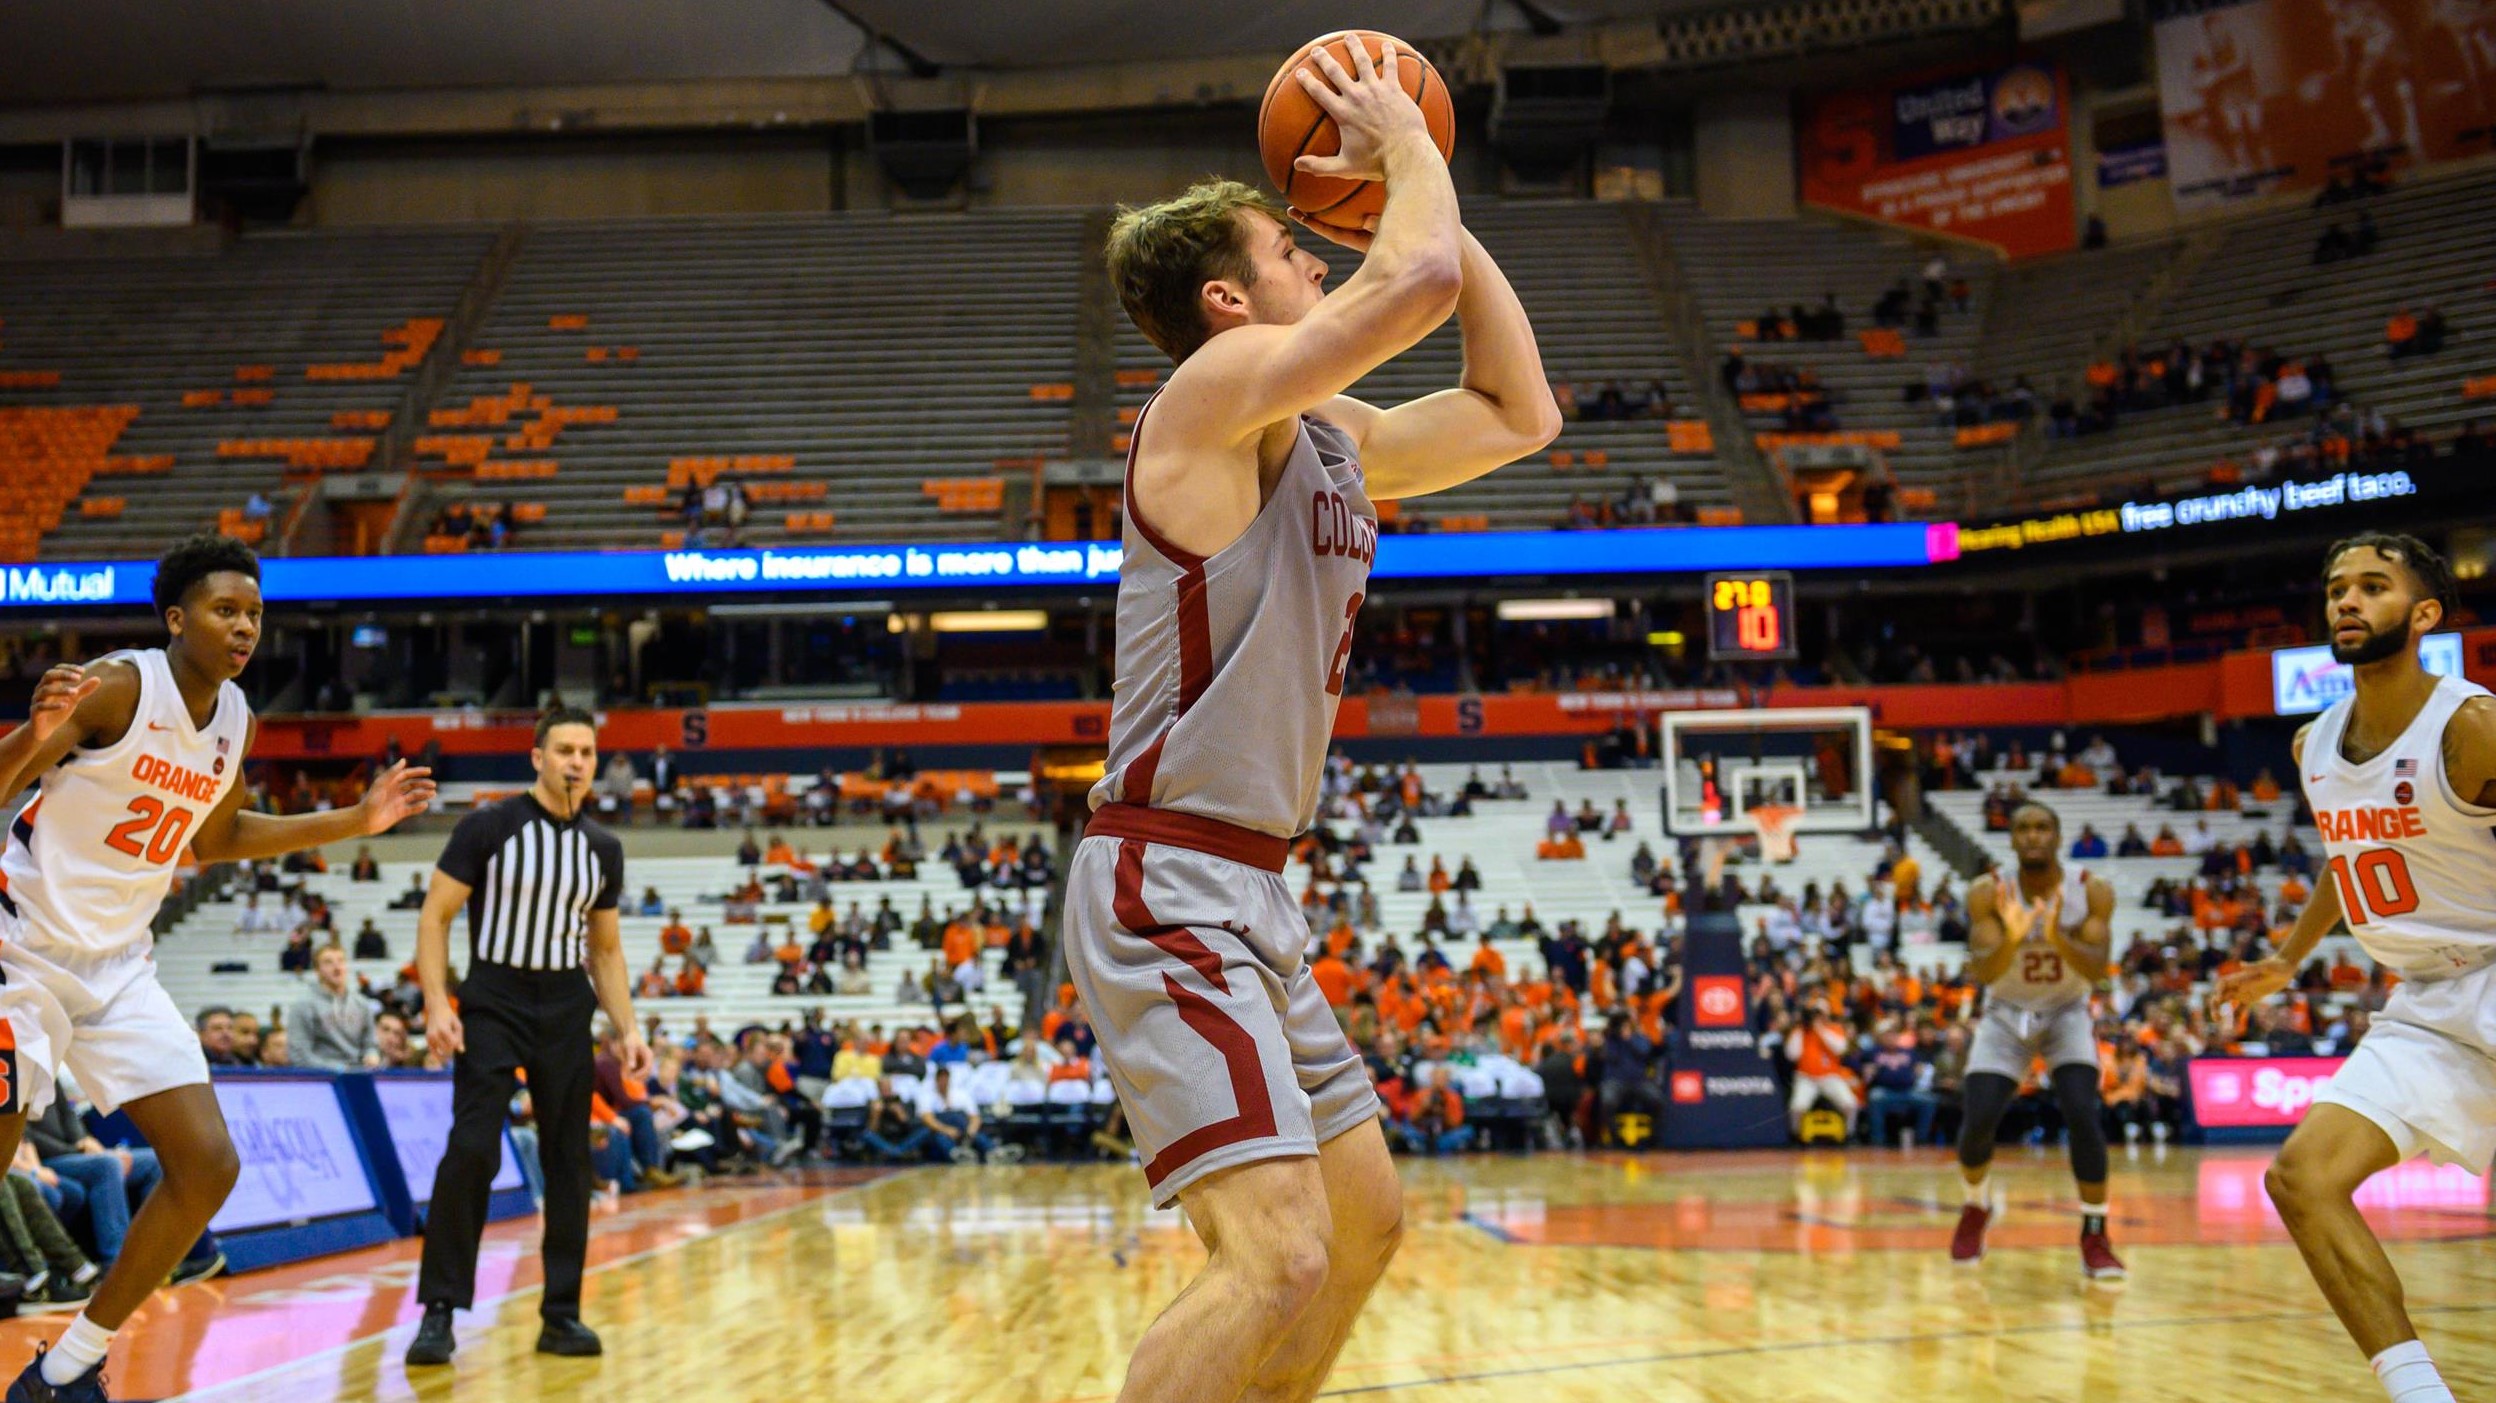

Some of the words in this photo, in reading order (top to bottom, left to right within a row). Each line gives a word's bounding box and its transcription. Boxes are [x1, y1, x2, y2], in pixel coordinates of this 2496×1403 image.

[2121, 502, 2174, 532] free
[2283, 473, 2346, 511] beef
[9, 565, 115, 601] Mutual
[665, 552, 758, 582] Where
[761, 551, 902, 580] insurance
[905, 548, 934, 577] is
[936, 551, 1014, 576] more
[1017, 545, 1083, 574] than
[1738, 606, 1779, 651] 10
[131, 753, 221, 804] ORANGE
[104, 794, 193, 865] 20
[2315, 807, 2427, 842] RANGE
[2329, 847, 2420, 926] 10
[2024, 951, 2064, 985] 23
